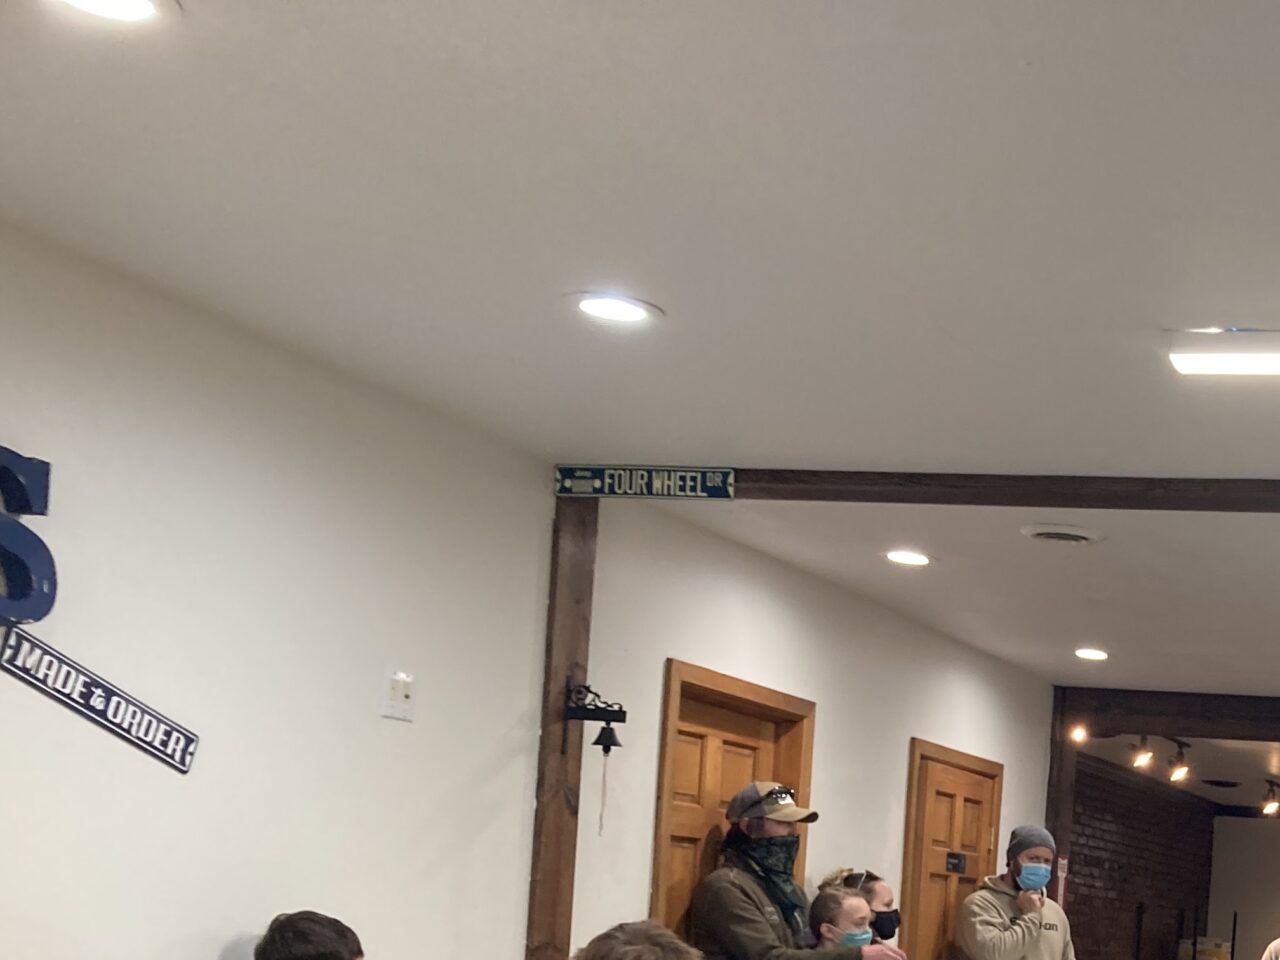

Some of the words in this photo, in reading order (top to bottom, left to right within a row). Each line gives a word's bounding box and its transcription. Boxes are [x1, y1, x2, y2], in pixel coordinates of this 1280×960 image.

[603, 469, 649, 495] FOUR
[651, 470, 708, 497] WHEEL
[706, 472, 723, 487] DR
[14, 639, 91, 704] MADE
[106, 696, 187, 763] ORDER
